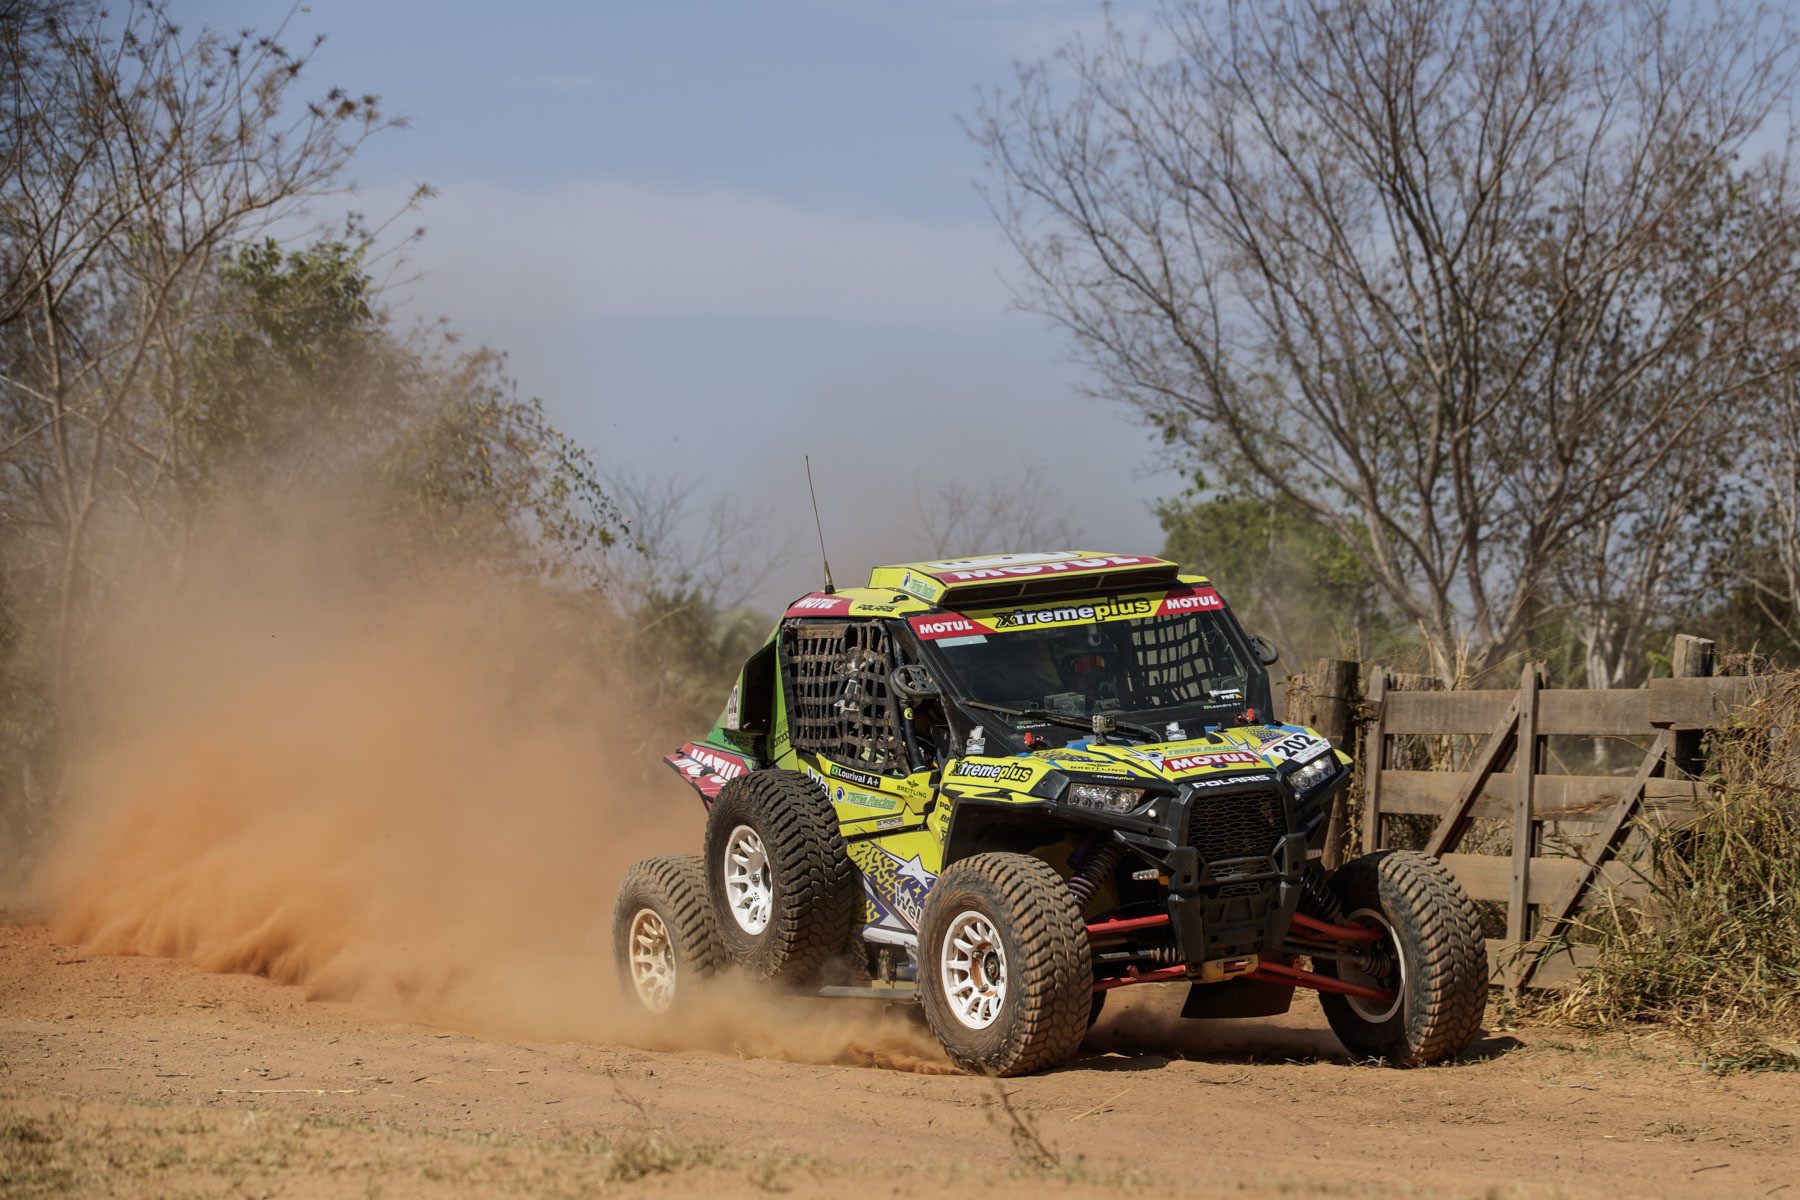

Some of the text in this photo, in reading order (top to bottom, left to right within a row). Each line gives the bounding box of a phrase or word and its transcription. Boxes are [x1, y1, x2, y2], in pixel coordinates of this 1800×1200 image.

[952, 556, 1140, 580] MOTUL
[794, 597, 842, 610] MOTUL
[856, 604, 898, 612] POLARIS
[1166, 595, 1220, 609] MOTUL
[919, 620, 973, 634] MOTUL
[1273, 735, 1319, 757] 202
[1170, 752, 1256, 770] MOTUL
[838, 768, 879, 786] Lourival A+
[1192, 774, 1271, 788] POLARIS
[896, 785, 927, 798] BREITLING
